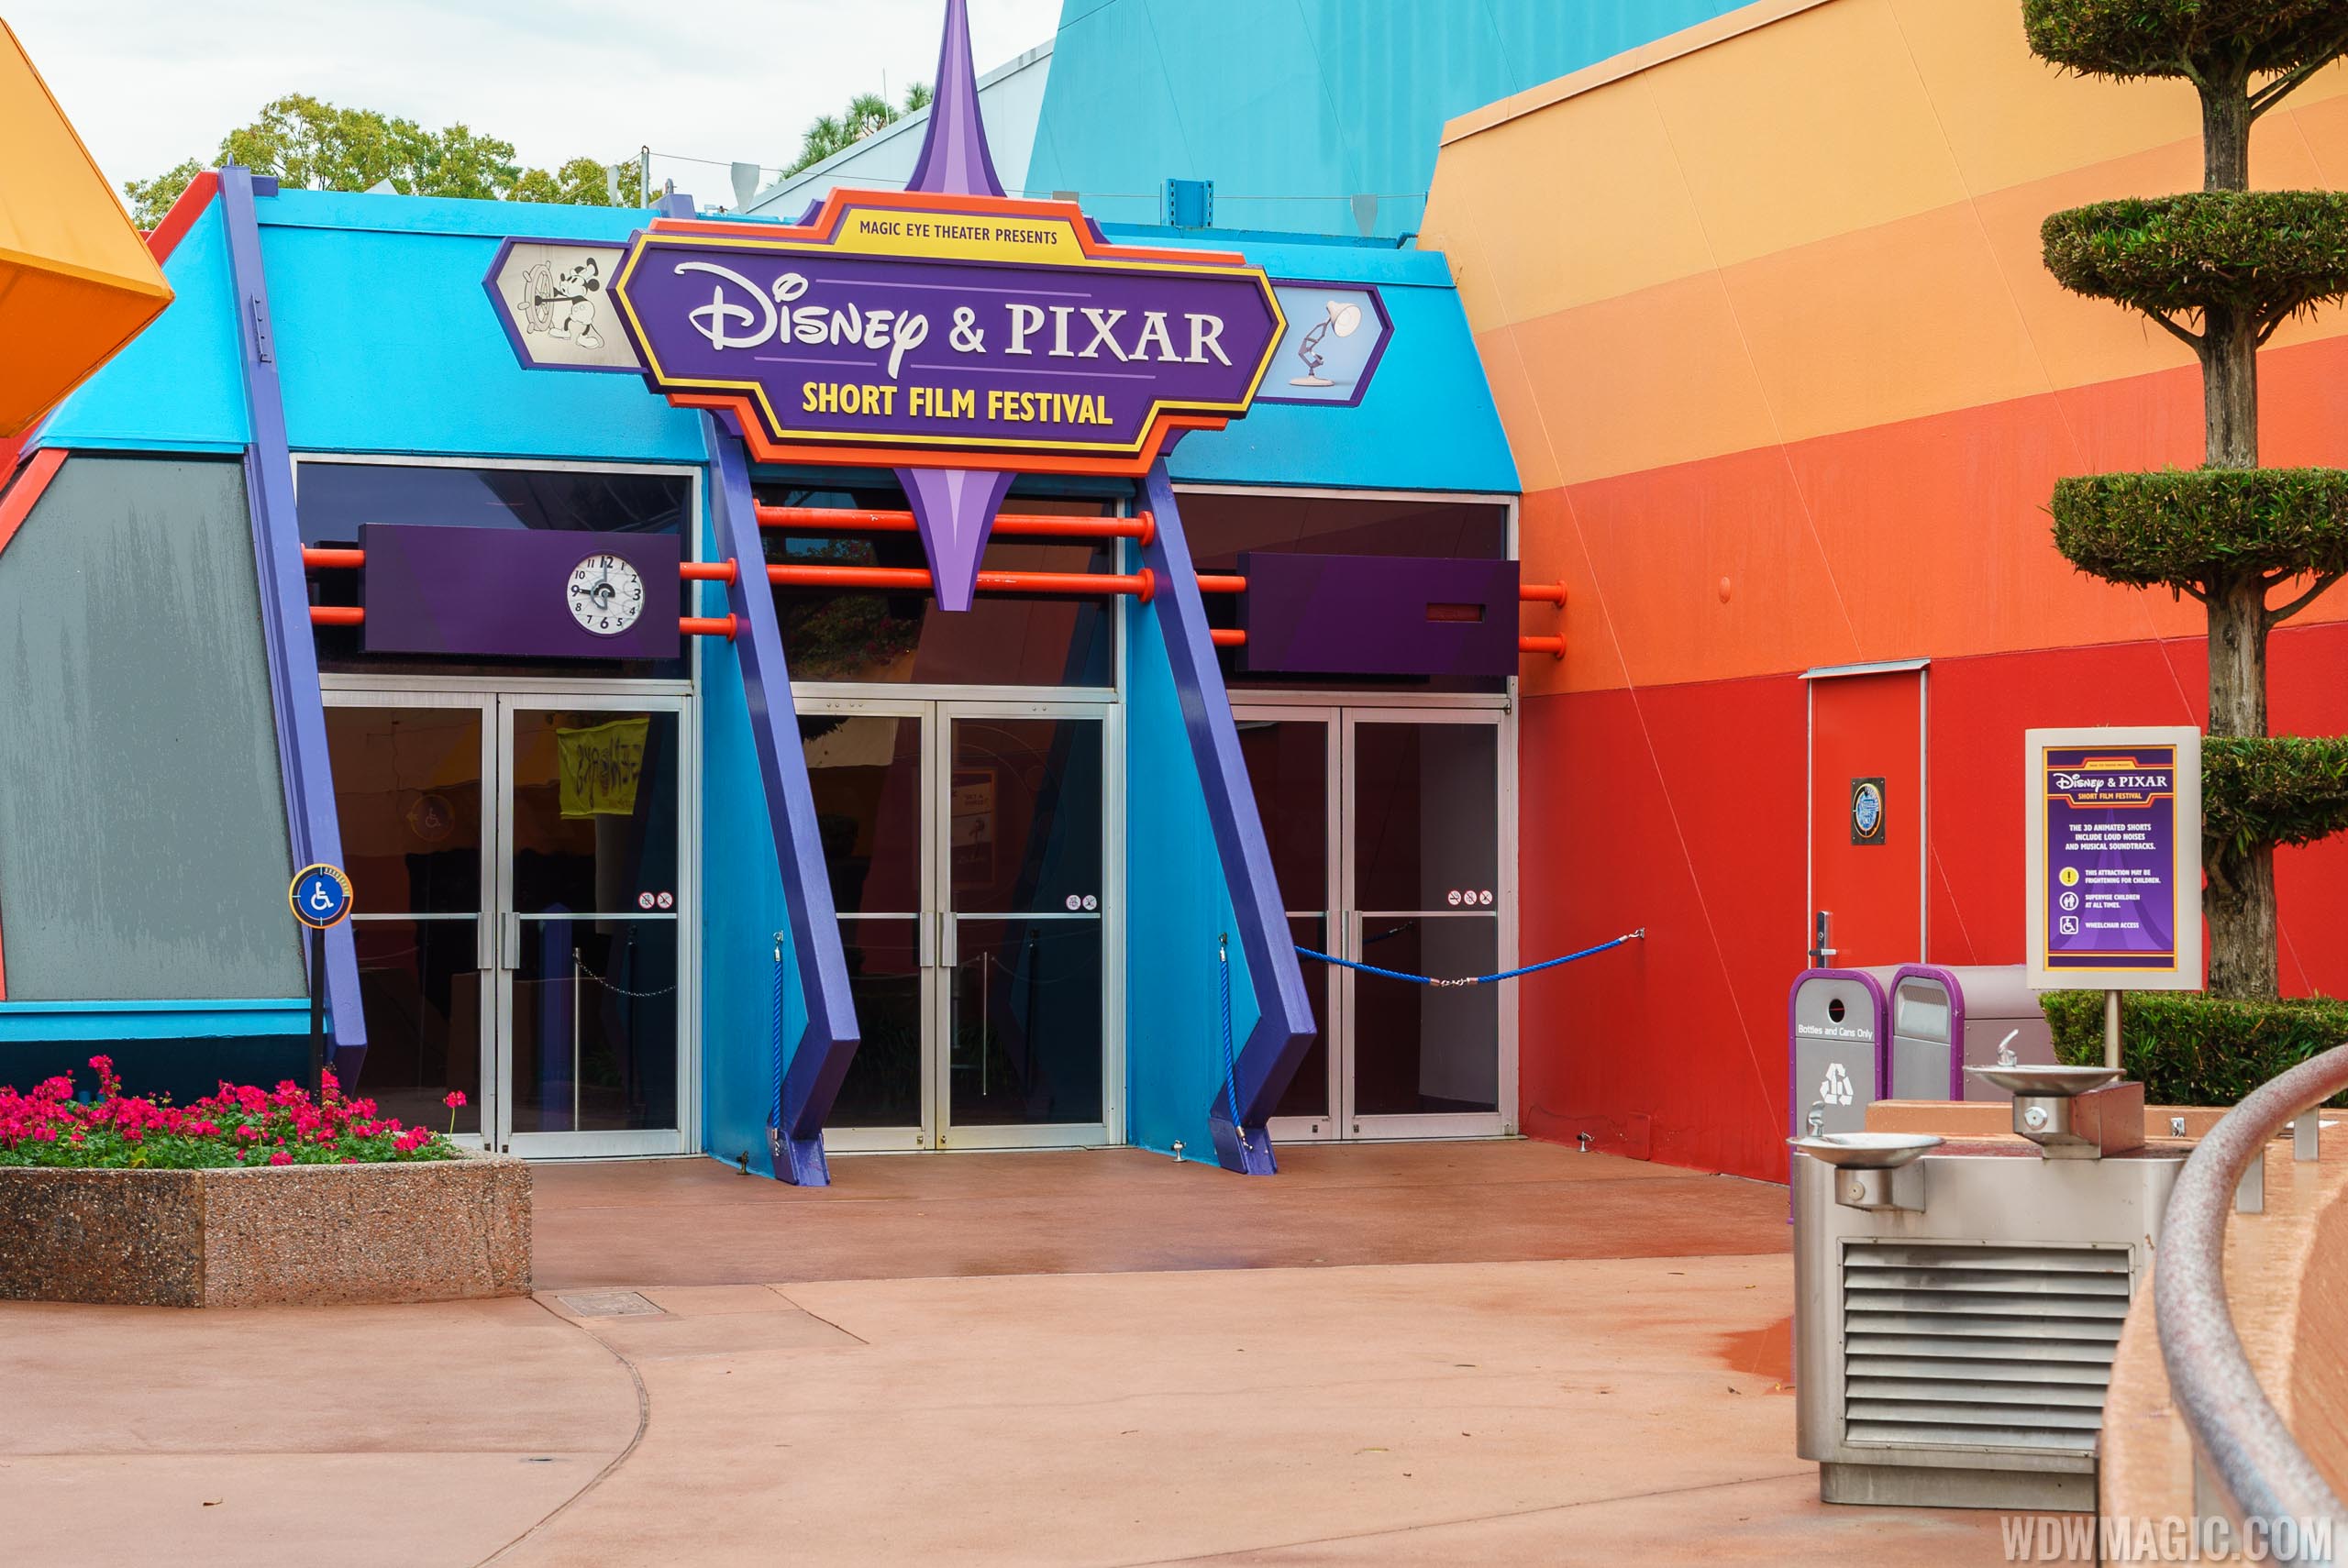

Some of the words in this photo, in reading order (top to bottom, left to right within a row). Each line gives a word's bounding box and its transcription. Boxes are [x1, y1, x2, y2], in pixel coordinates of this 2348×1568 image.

[859, 220, 901, 236] MAGIC
[906, 224, 930, 237] EYE
[934, 225, 991, 241] THEATER
[995, 228, 1058, 245] PRESENTS
[949, 306, 987, 354] &
[1005, 303, 1233, 367] PIXAR
[803, 381, 898, 415] SHORT
[909, 387, 976, 419] FILM
[988, 390, 1114, 425] FESTIVAL
[587, 558, 595, 569] 11
[600, 556, 614, 569] 12
[621, 562, 625, 570] 1
[574, 570, 585, 580] 10
[631, 574, 637, 583] 2
[571, 585, 580, 597] 9
[632, 589, 641, 601] 3
[575, 602, 581, 612] 8
[629, 607, 636, 615] 4
[587, 615, 593, 624] 7
[600, 617, 609, 629] 6
[616, 617, 623, 626] 5
[2107, 778, 2116, 788] &
[2119, 776, 2168, 788] PIXAR
[2069, 823, 2082, 832] THE
[2093, 823, 2125, 832] ANIMATED
[2122, 833, 2146, 841] NOISES
[1798, 1024, 1823, 1035] Bottles
[1824, 1027, 1837, 1036] and
[1839, 1027, 1855, 1037] Cans
[1856, 1028, 1873, 1041] Only
